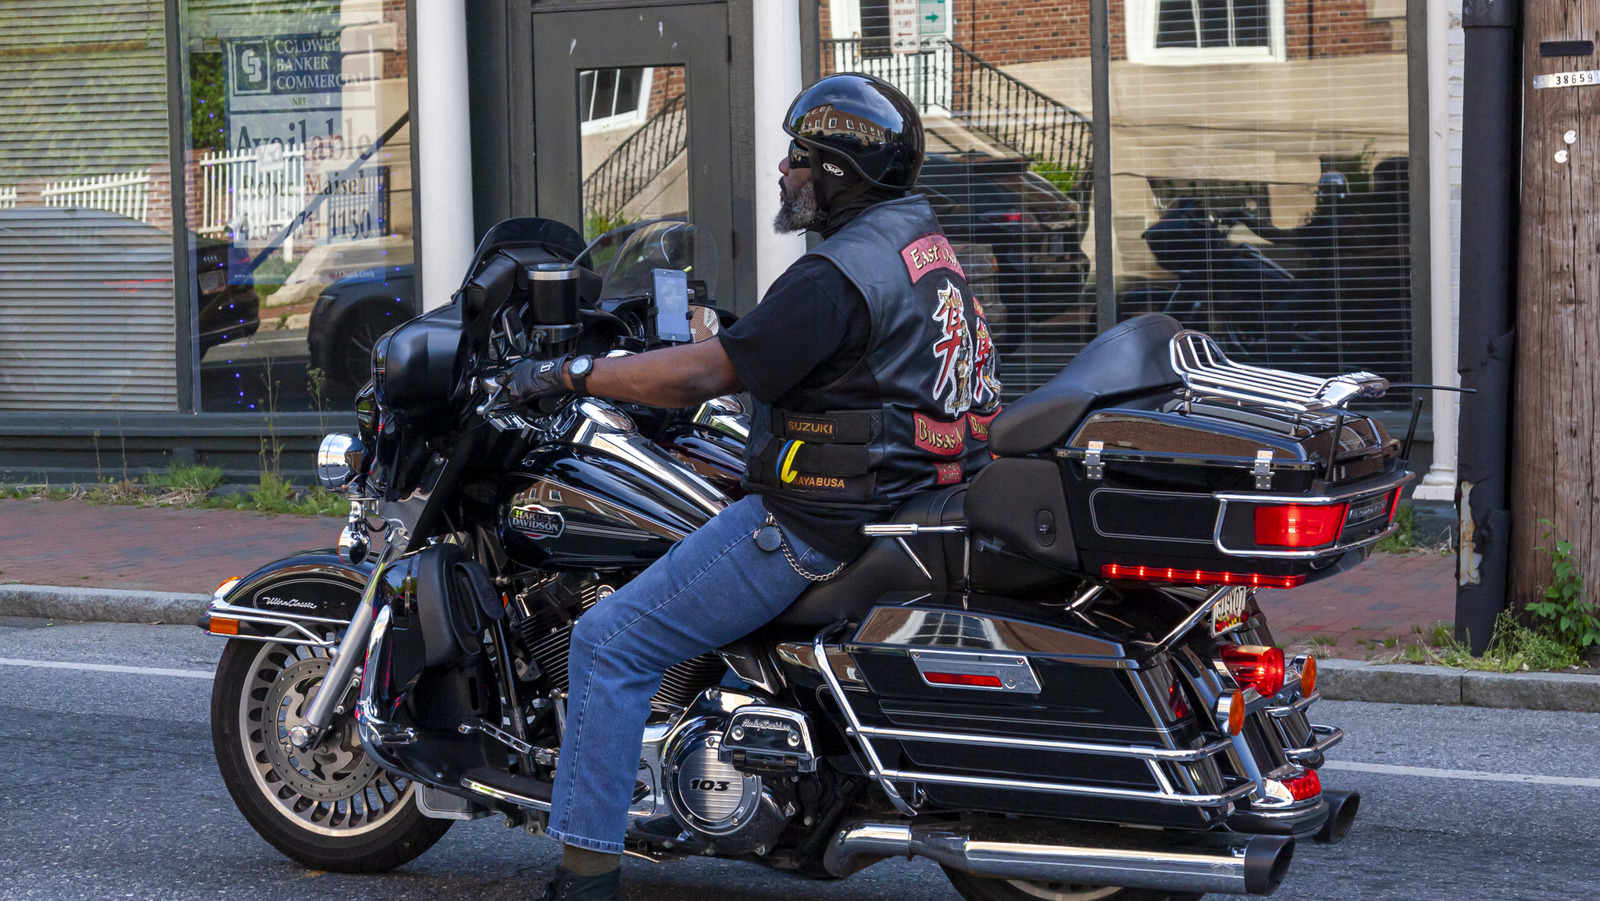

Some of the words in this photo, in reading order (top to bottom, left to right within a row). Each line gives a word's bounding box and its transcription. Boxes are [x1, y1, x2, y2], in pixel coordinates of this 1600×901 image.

[276, 56, 329, 72] BANKER
[276, 72, 367, 90] COMMERCIAL
[292, 97, 307, 106] NRT
[305, 169, 367, 196] Maisel
[910, 244, 940, 270] East
[788, 421, 833, 434] SUZUKI
[512, 517, 558, 532] DAVIDSON
[689, 778, 731, 792] 103
